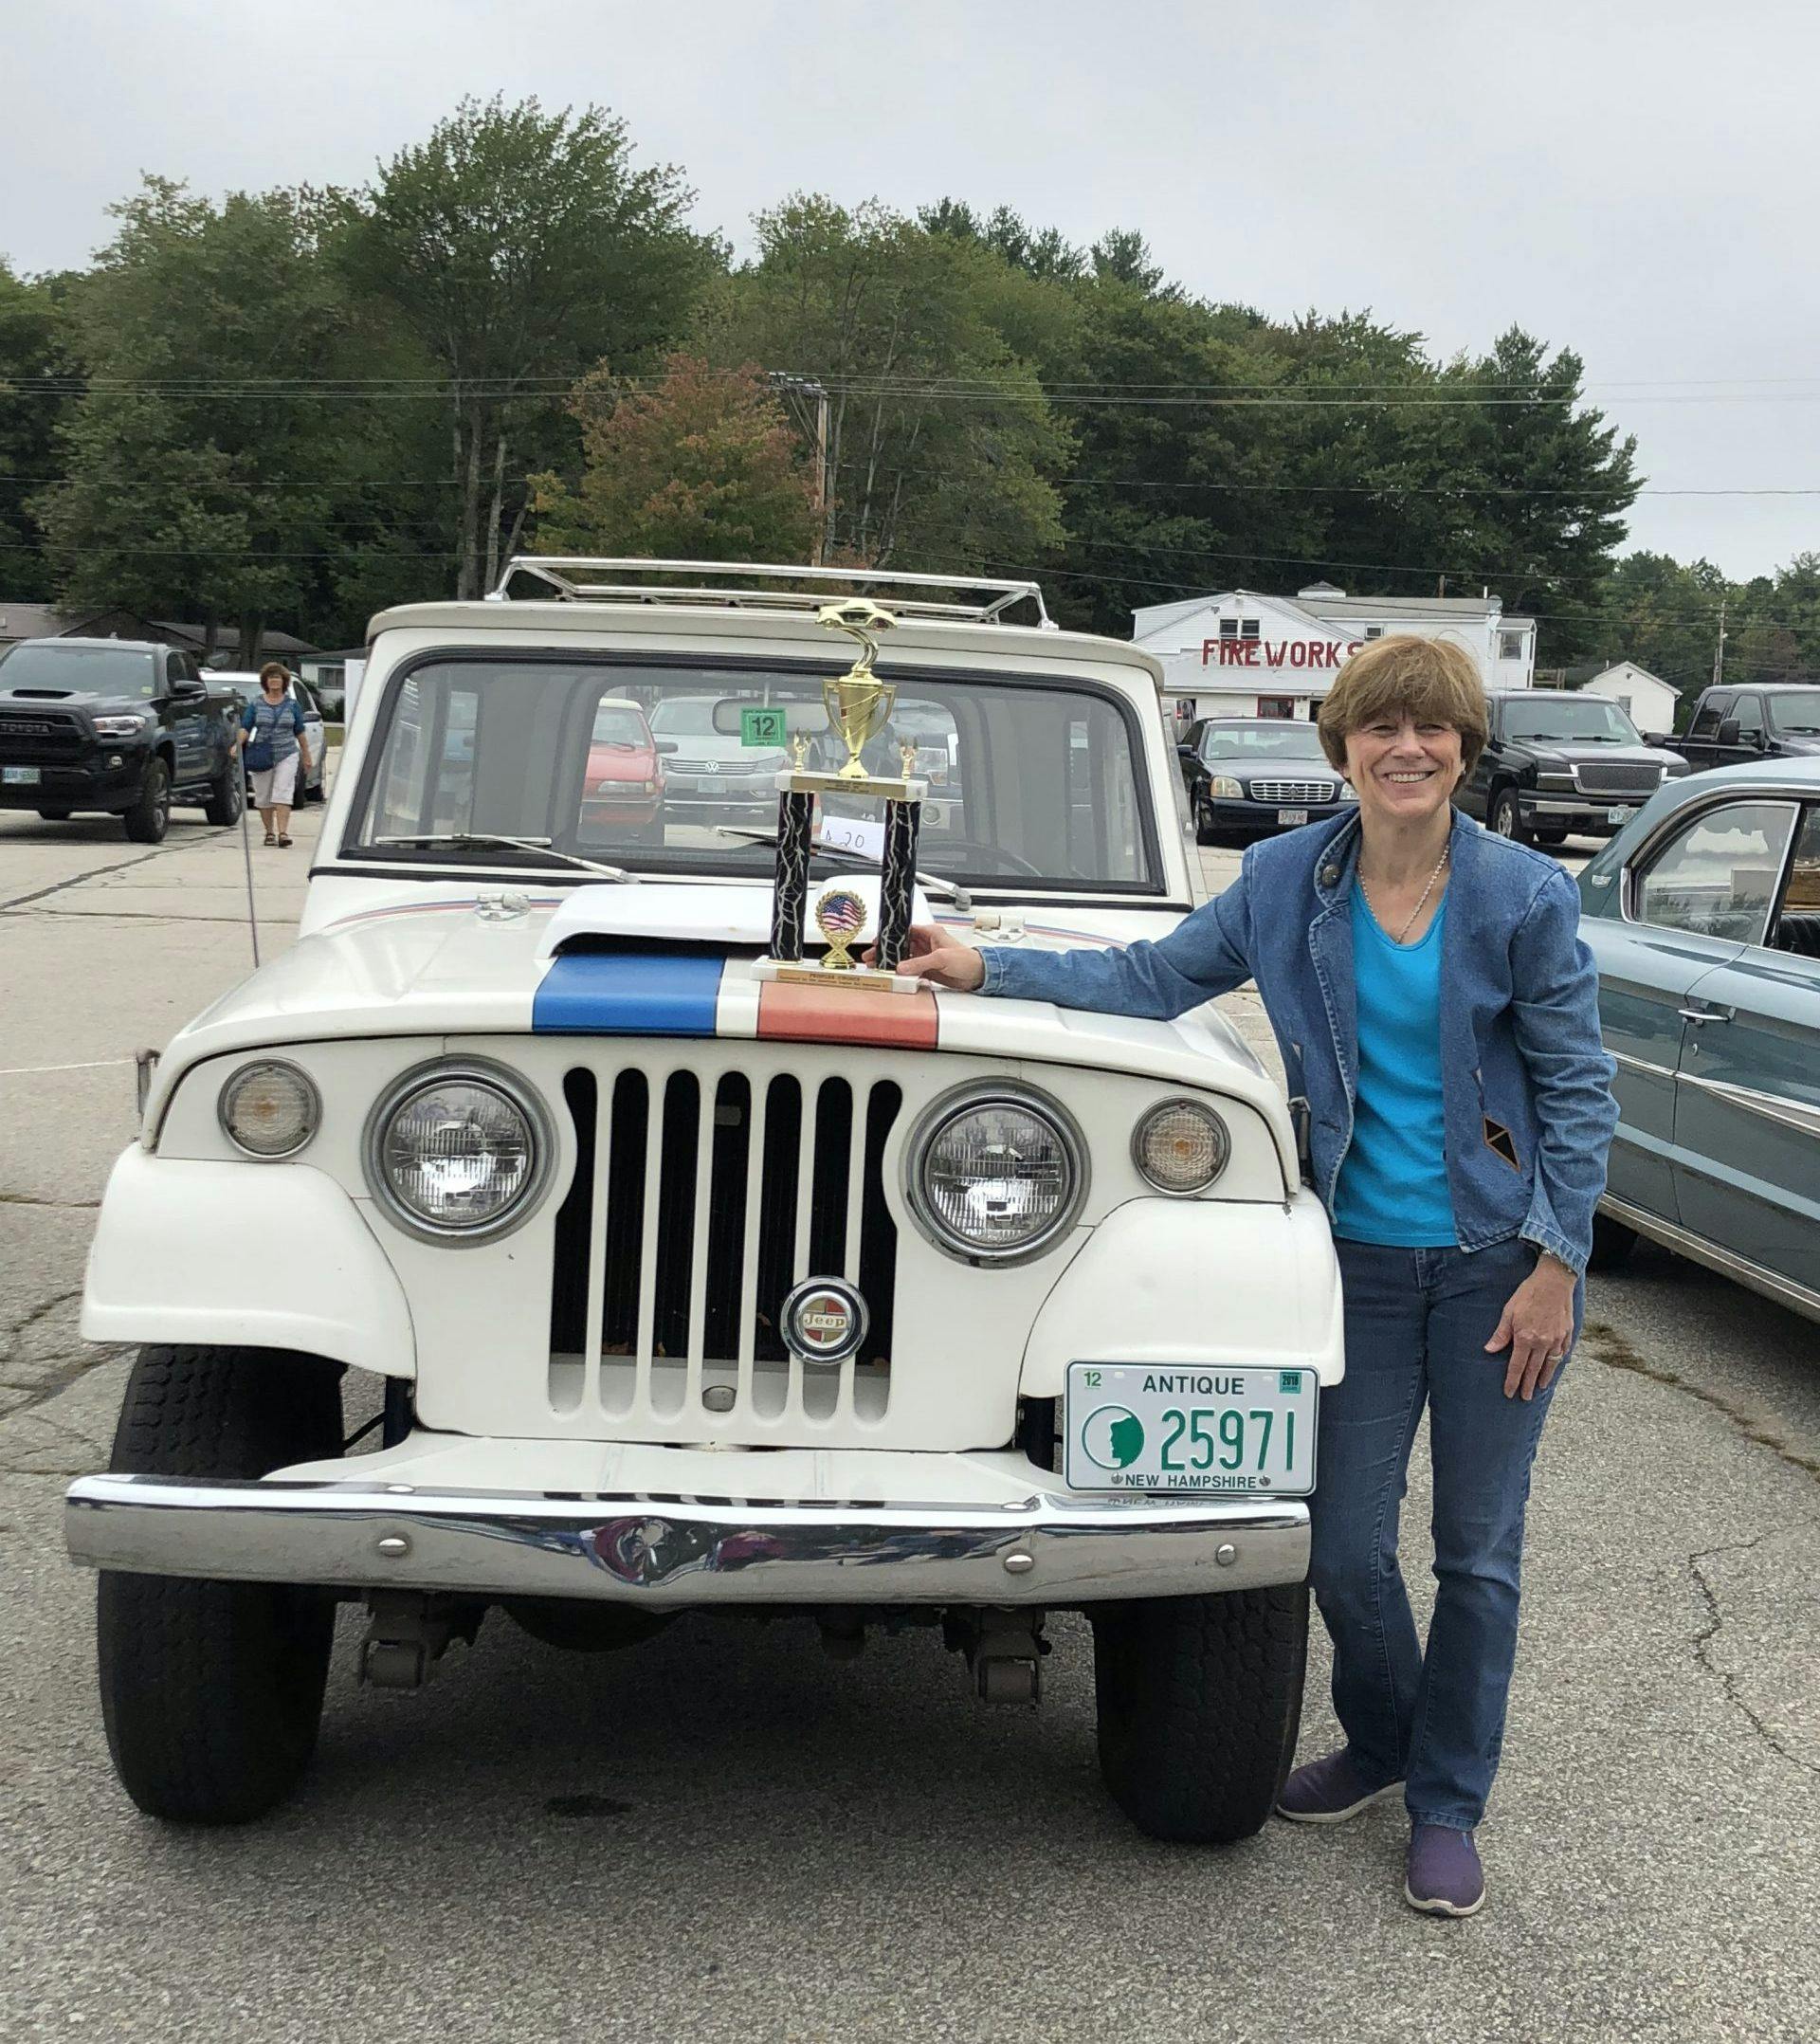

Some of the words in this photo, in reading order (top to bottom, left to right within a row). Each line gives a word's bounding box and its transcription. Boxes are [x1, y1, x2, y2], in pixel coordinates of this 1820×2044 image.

[752, 717, 775, 736] 12
[805, 1313, 845, 1326] Jeep
[1084, 1372, 1101, 1386] 12
[1142, 1375, 1245, 1396] ANTIQUE
[1161, 1409, 1295, 1471] 25971
[1125, 1473, 1159, 1487] NEW
[1168, 1474, 1257, 1488] HAMPSHIRE
